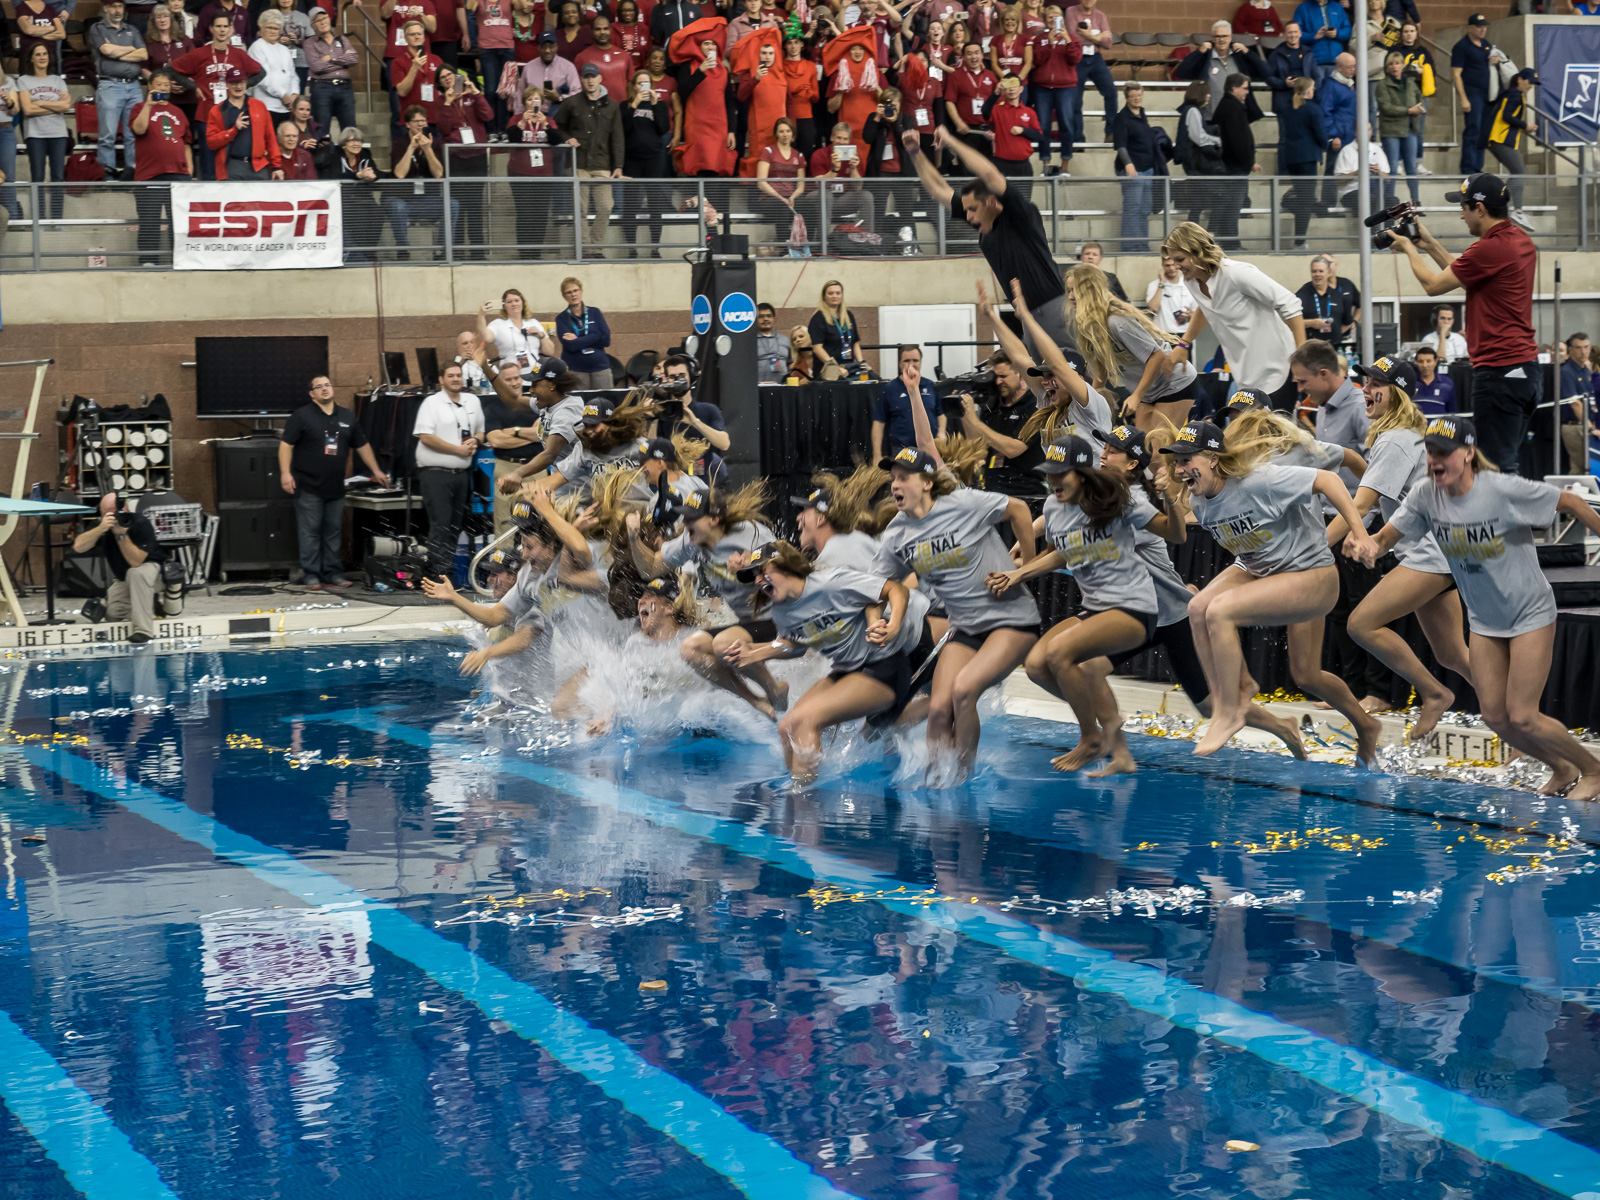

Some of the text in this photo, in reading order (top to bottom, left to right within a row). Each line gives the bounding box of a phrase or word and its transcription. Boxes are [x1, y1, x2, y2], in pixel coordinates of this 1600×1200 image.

[187, 199, 330, 238] ESPN
[185, 243, 201, 251] THE
[204, 243, 253, 252] WORLDWIDE
[255, 243, 285, 252] LEADER
[296, 242, 327, 251] SPORTS
[724, 311, 755, 322] NCAA
[153, 623, 202, 639] .96M
